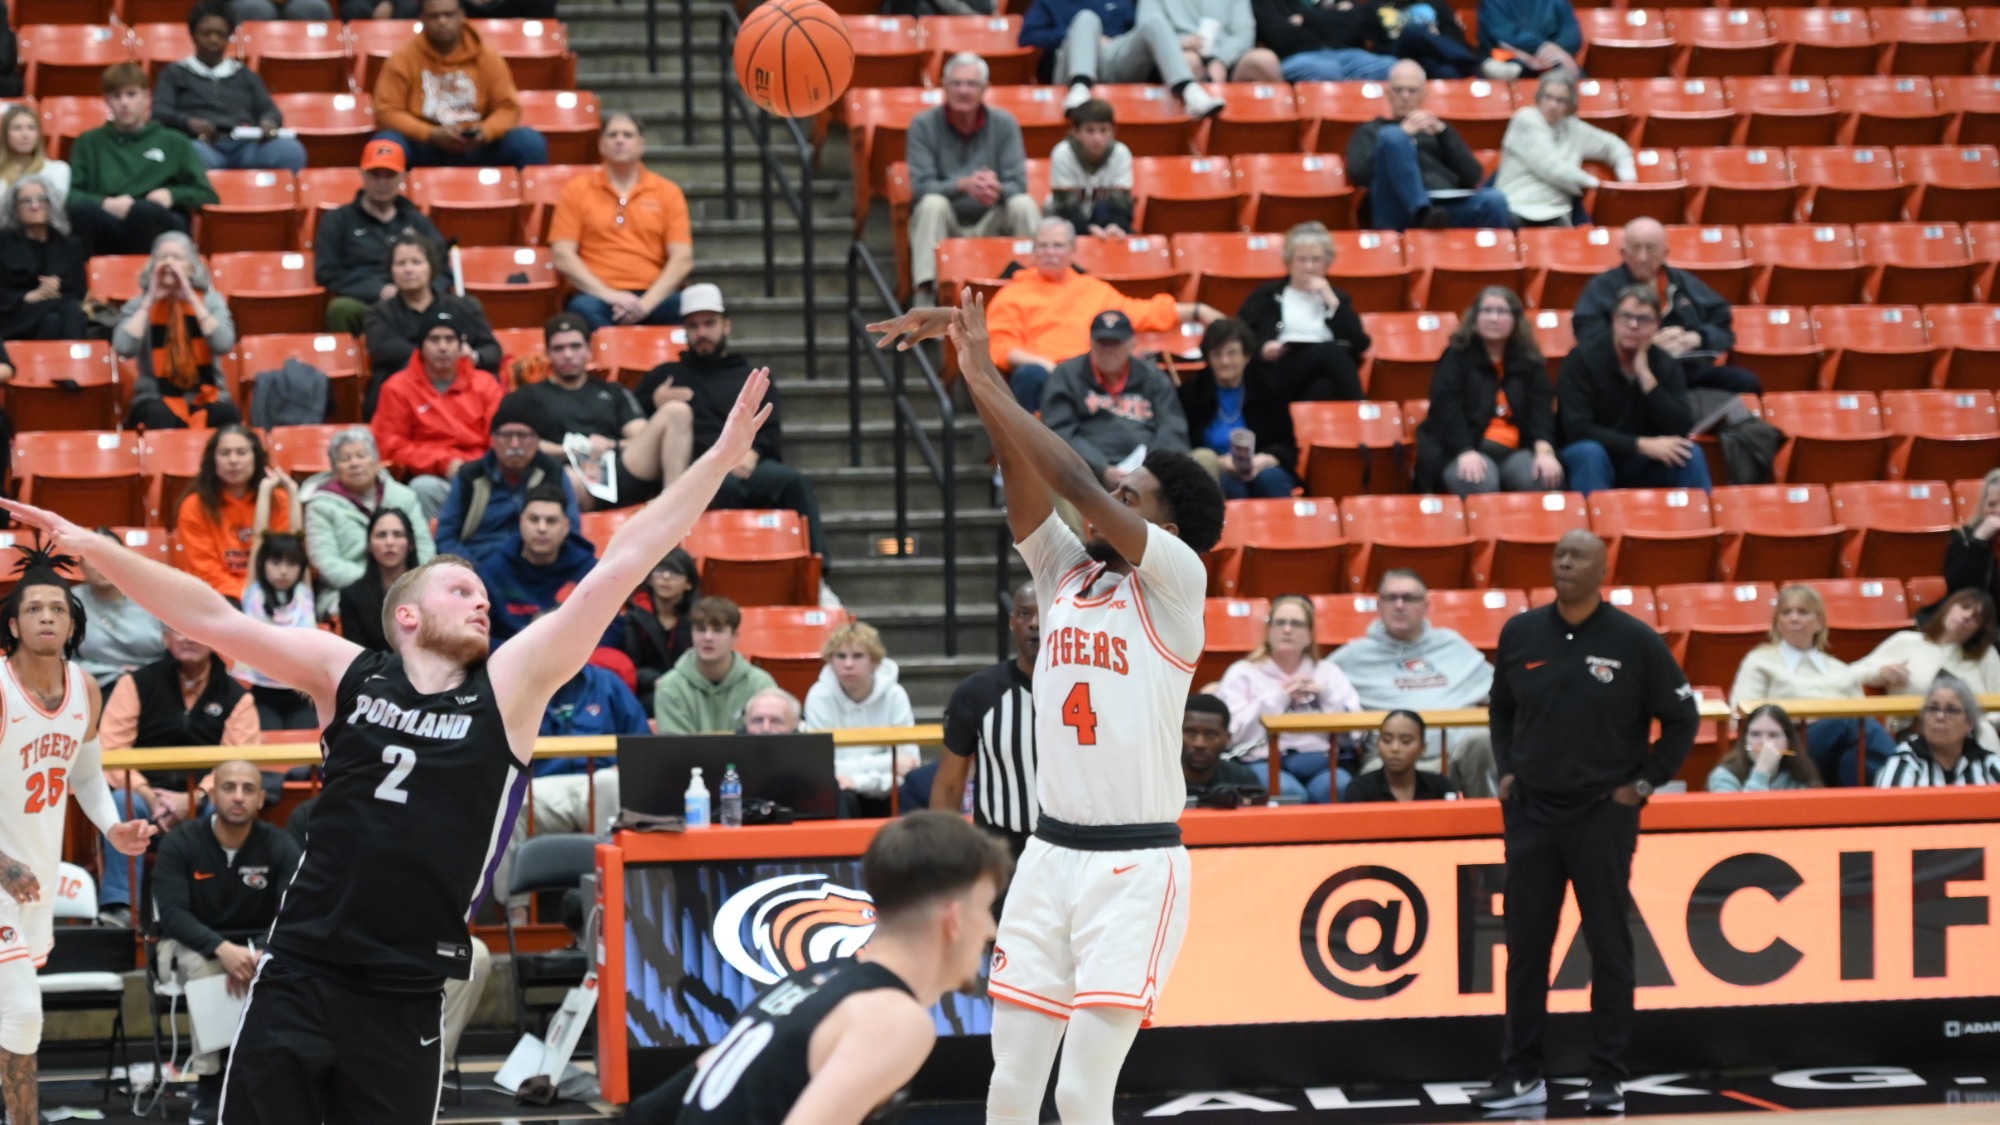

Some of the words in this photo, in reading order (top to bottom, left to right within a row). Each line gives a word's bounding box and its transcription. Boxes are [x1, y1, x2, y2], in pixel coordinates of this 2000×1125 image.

[347, 694, 472, 740] PORTLAND
[1062, 682, 1097, 745] 4
[24, 767, 66, 814] 25
[374, 744, 417, 805] 2
